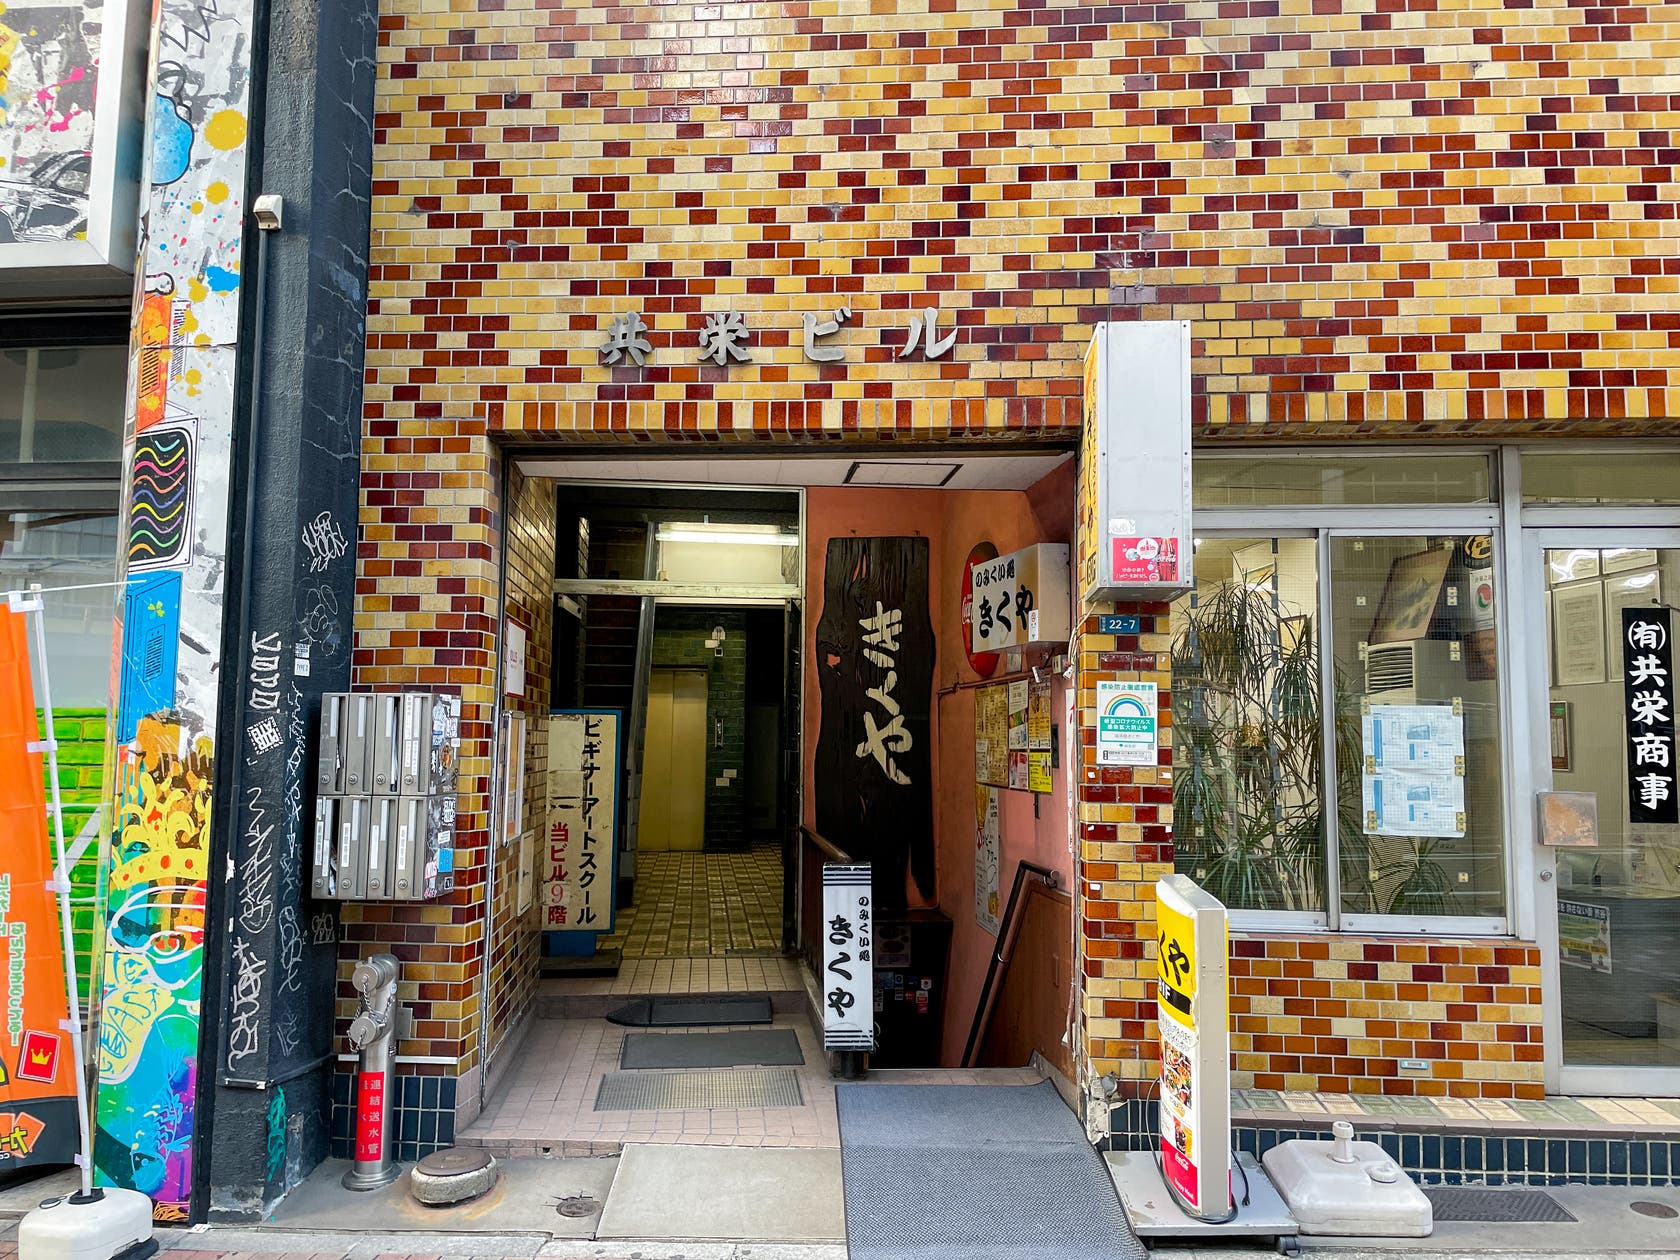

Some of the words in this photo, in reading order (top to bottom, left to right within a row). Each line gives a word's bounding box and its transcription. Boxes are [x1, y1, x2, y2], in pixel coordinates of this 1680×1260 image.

[601, 306, 958, 367] 共栄ビル
[976, 558, 1015, 587] のみくい処
[979, 584, 1034, 638] きくや
[1109, 619, 1136, 630] 22-7
[856, 601, 913, 785] きくや
[576, 718, 603, 926] ビギナーアートスクール
[547, 821, 569, 925] 当ビル9階
[858, 896, 871, 962] のみくい処
[827, 914, 855, 1018] きくや
[367, 1079, 382, 1154] 連結送水管
